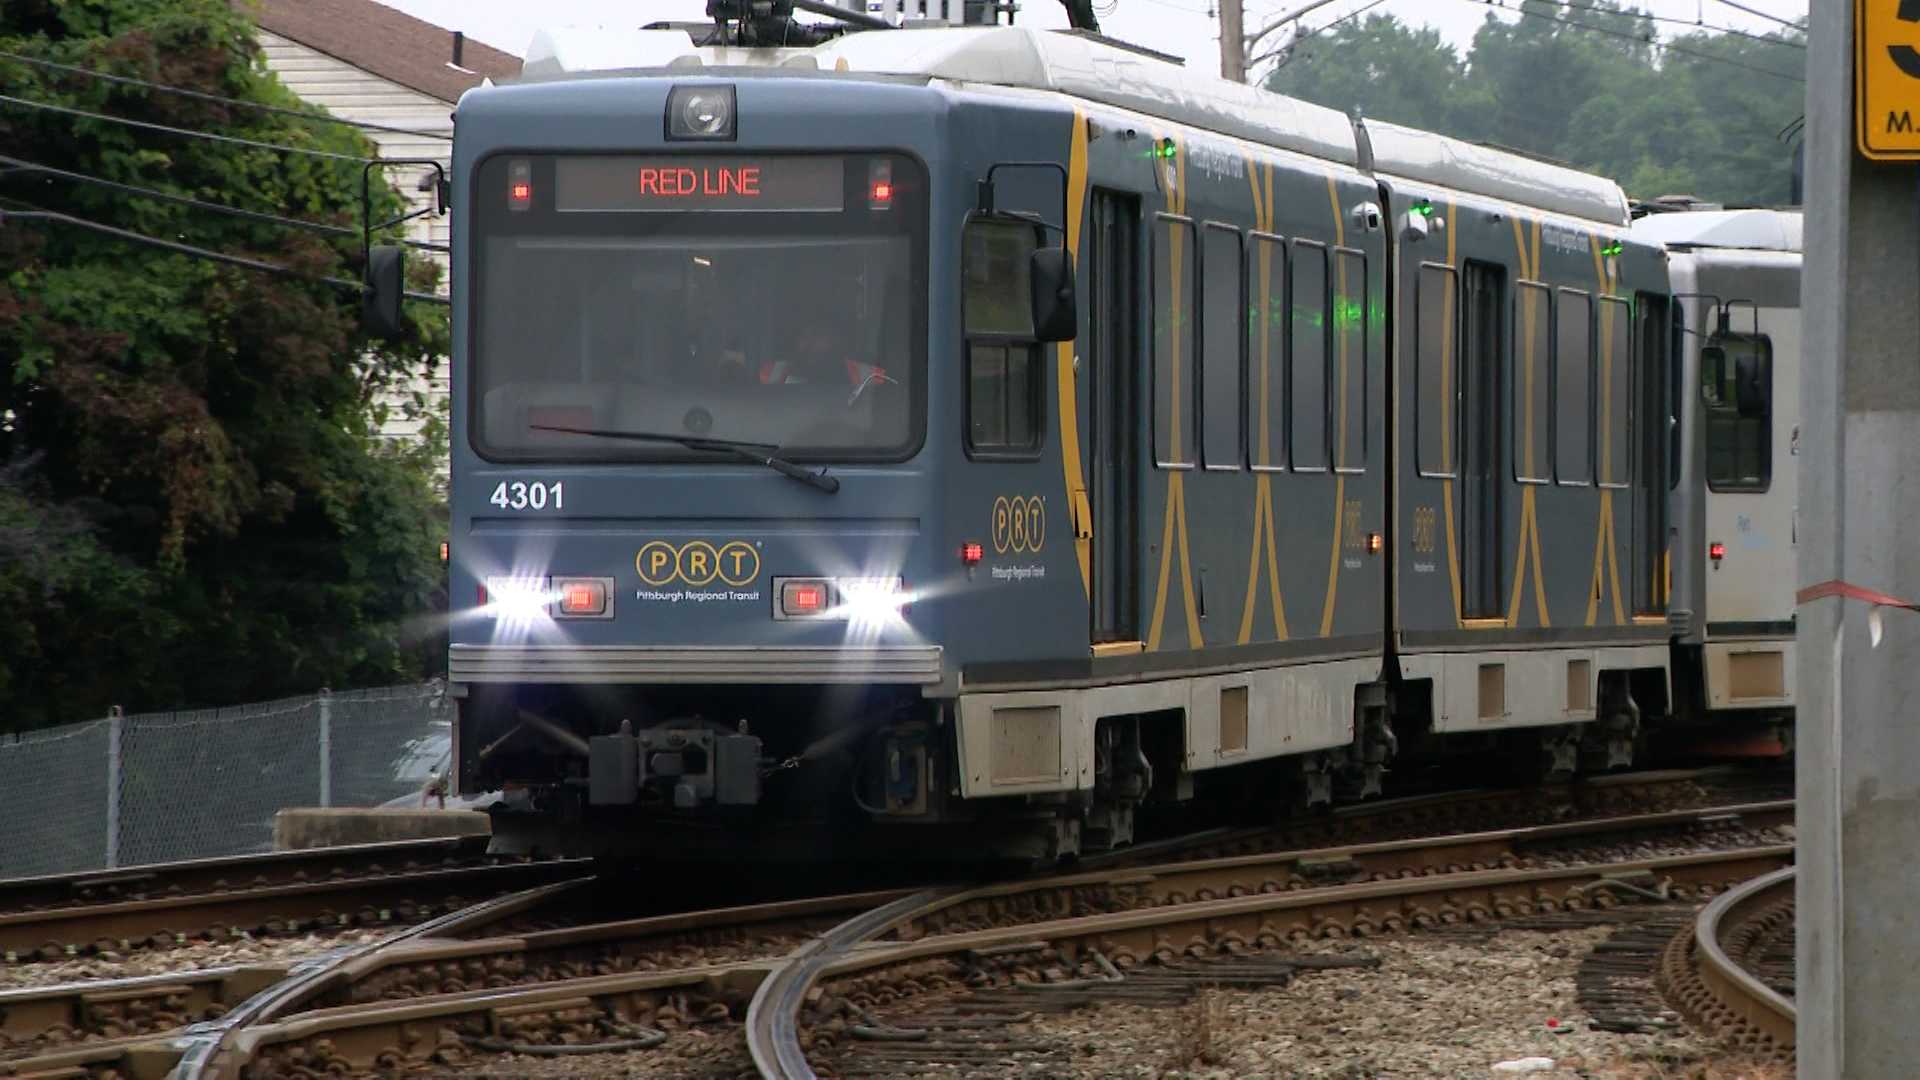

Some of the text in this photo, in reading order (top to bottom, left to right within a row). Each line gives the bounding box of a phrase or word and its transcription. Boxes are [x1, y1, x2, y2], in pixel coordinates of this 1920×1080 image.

[639, 168, 761, 195] RED LINE
[490, 480, 564, 511] 4301
[648, 548, 750, 580] PRT
[636, 590, 760, 602] Pittsburgh Regional Transit
